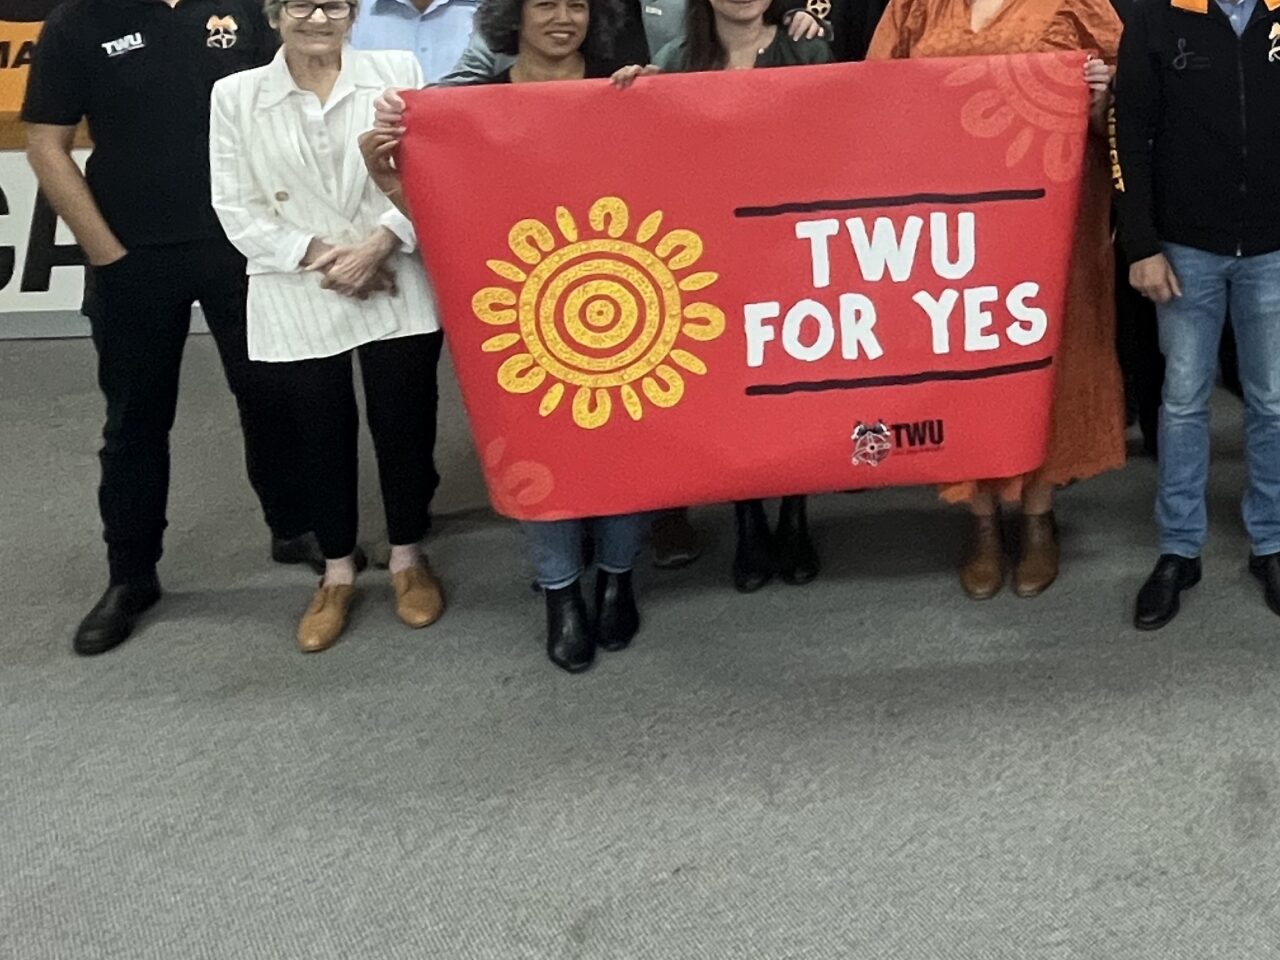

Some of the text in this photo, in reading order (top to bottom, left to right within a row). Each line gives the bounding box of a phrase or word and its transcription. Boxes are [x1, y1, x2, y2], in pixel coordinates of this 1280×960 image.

[101, 32, 142, 55] TWU
[795, 211, 976, 288] TWU
[744, 282, 1048, 368] FOR YES
[891, 419, 944, 448] TWU
